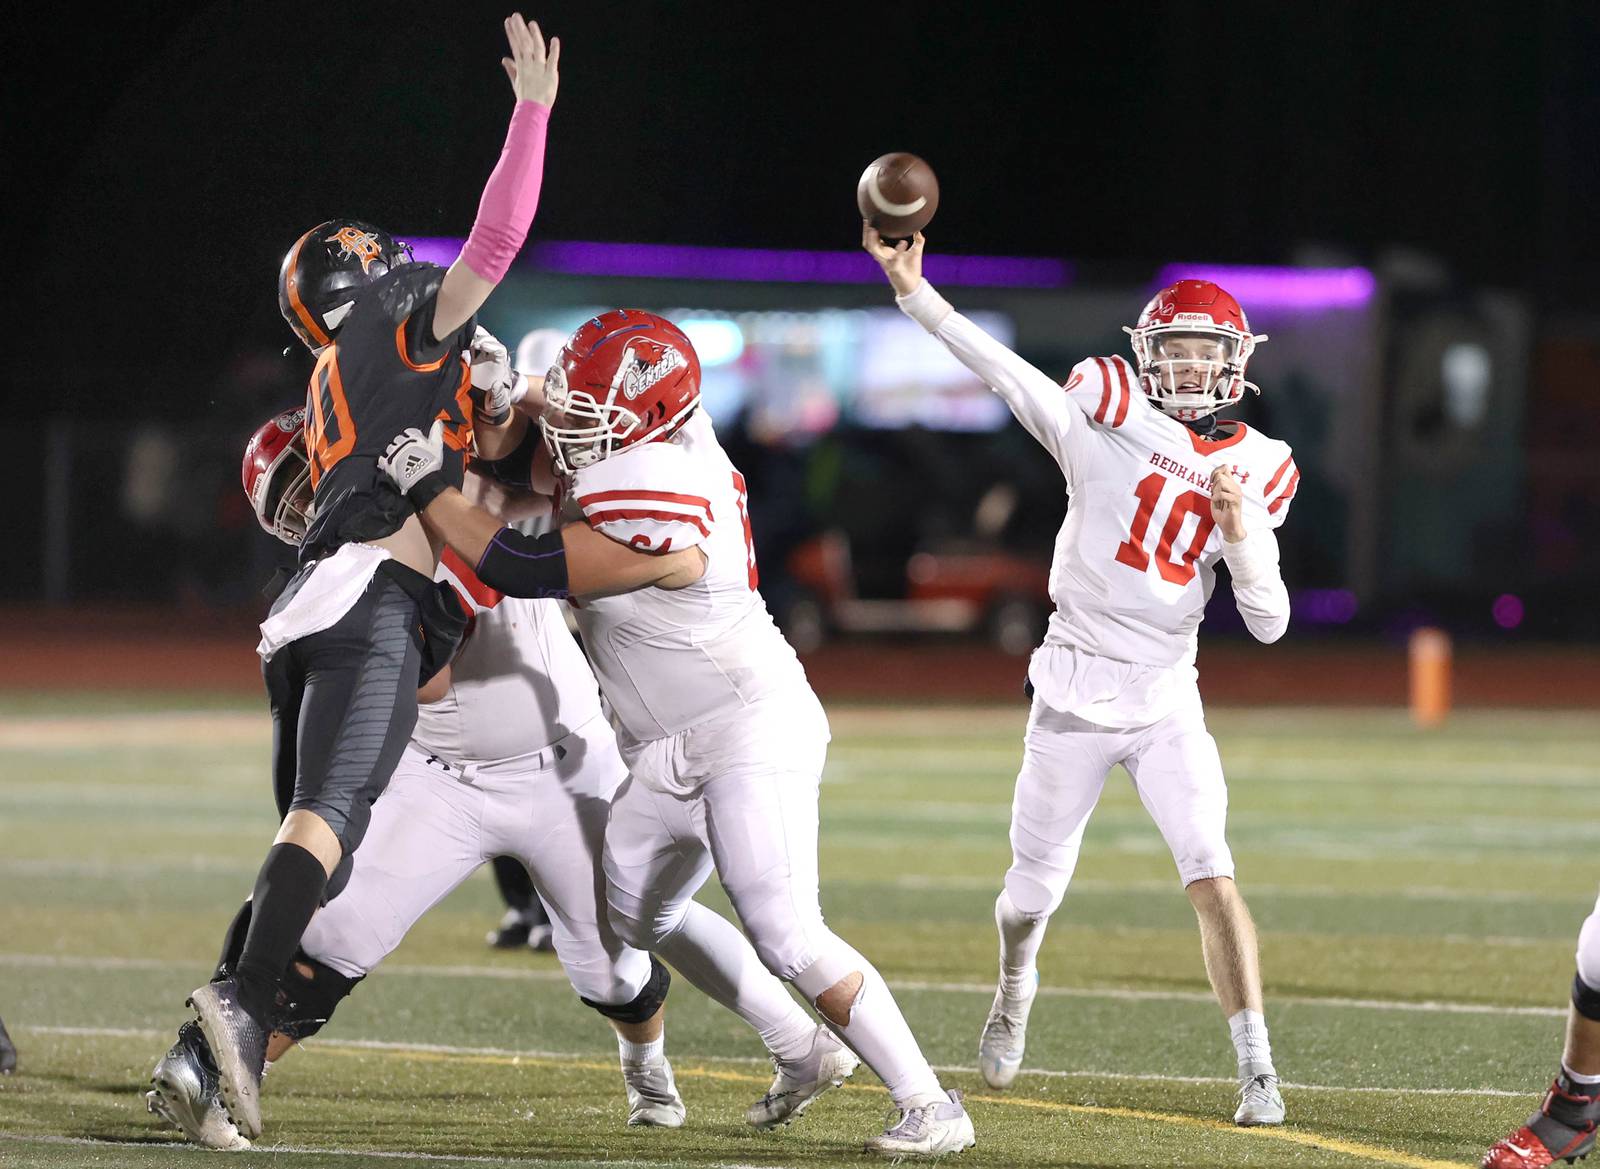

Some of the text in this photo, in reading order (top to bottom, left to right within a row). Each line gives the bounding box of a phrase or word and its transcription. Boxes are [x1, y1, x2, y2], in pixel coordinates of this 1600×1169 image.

[1177, 313, 1208, 321] Riddell
[405, 458, 428, 479] adidas
[1149, 452, 1213, 492] REDHAWK
[1114, 472, 1216, 586] 10
